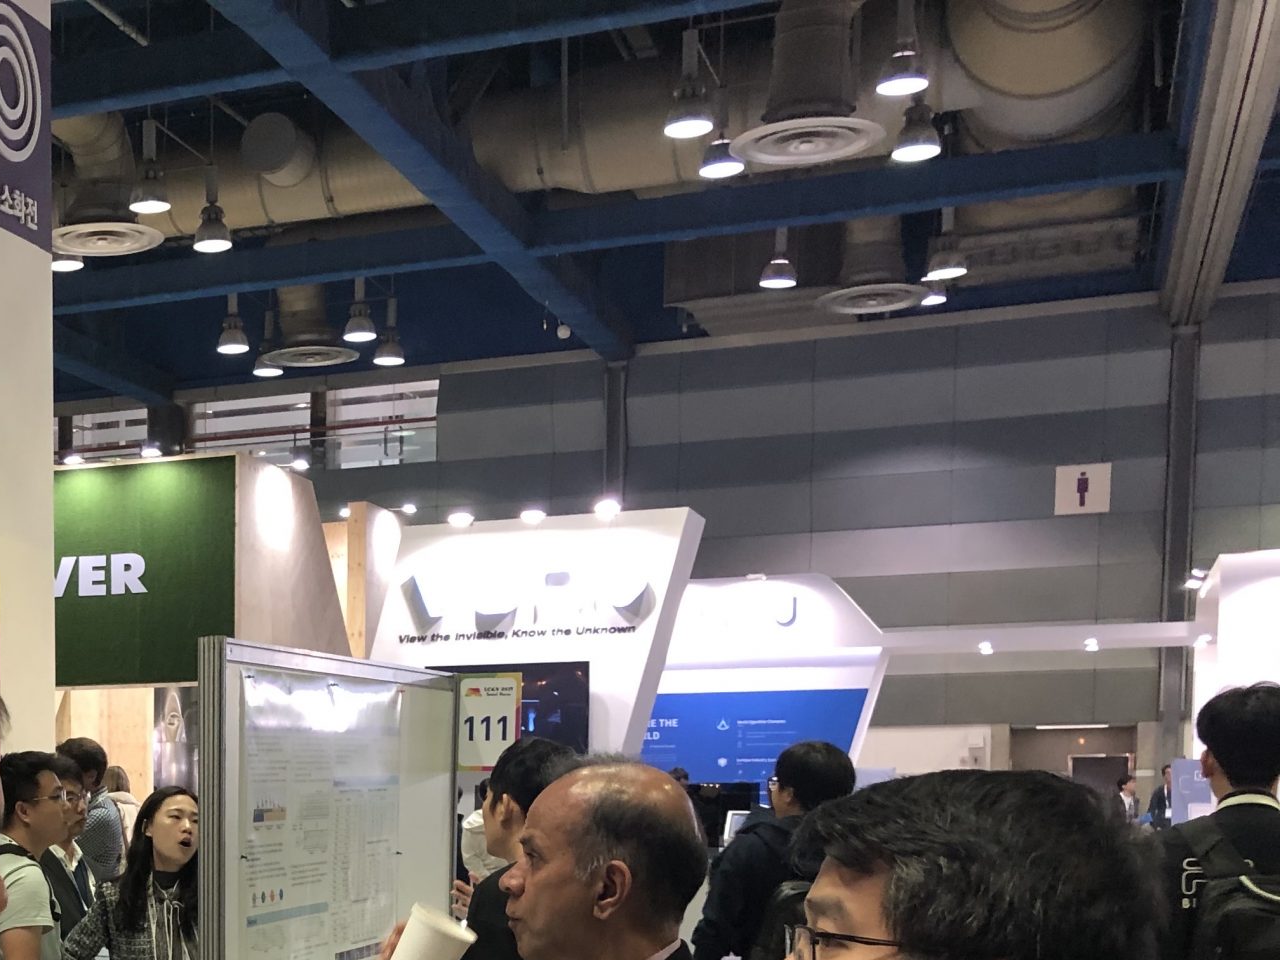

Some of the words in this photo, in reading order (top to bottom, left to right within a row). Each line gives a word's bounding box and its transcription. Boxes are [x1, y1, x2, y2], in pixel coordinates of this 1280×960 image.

[398, 633, 427, 644] View
[430, 632, 450, 642] the
[511, 628, 547, 638] Know
[551, 626, 572, 636] the
[575, 624, 636, 635] Unknown
[464, 715, 507, 741] 111
[659, 718, 679, 728] THE
